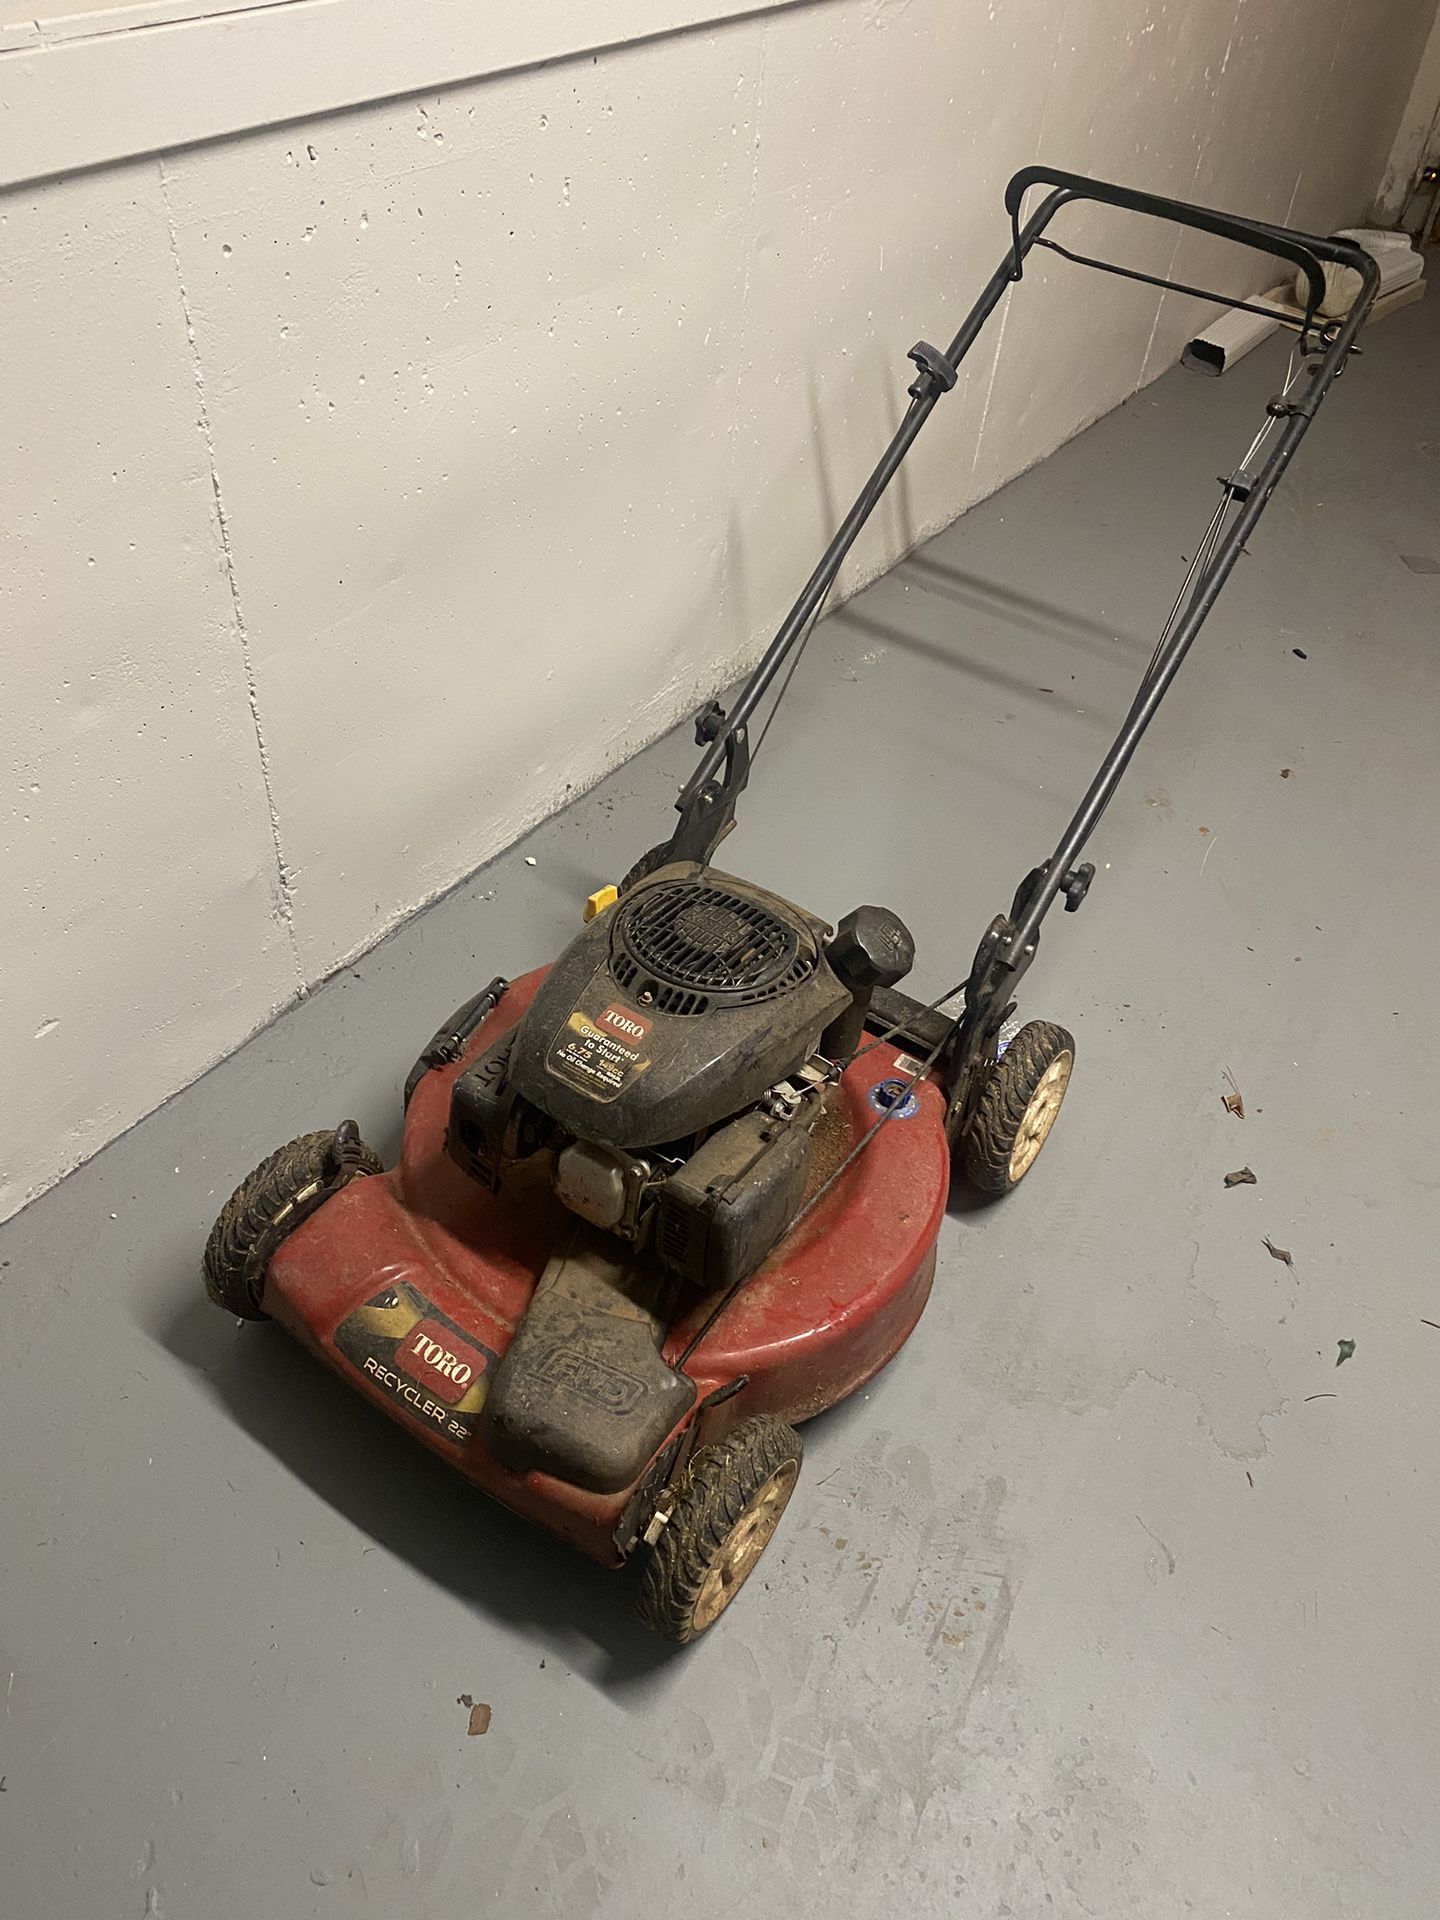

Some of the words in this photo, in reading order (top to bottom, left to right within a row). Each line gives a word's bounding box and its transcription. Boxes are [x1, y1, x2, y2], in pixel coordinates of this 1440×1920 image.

[604, 1010, 644, 1038] TORO
[567, 1042, 593, 1059] 6.75
[580, 1026, 640, 1061] Guaranteed
[584, 1039, 595, 1049] to
[556, 1049, 566, 1058] No
[566, 1053, 577, 1063] Oil
[575, 1059, 596, 1075] Change
[596, 1070, 622, 1088] Required
[410, 1332, 472, 1385] TORO
[363, 1357, 447, 1424] RECYCLER
